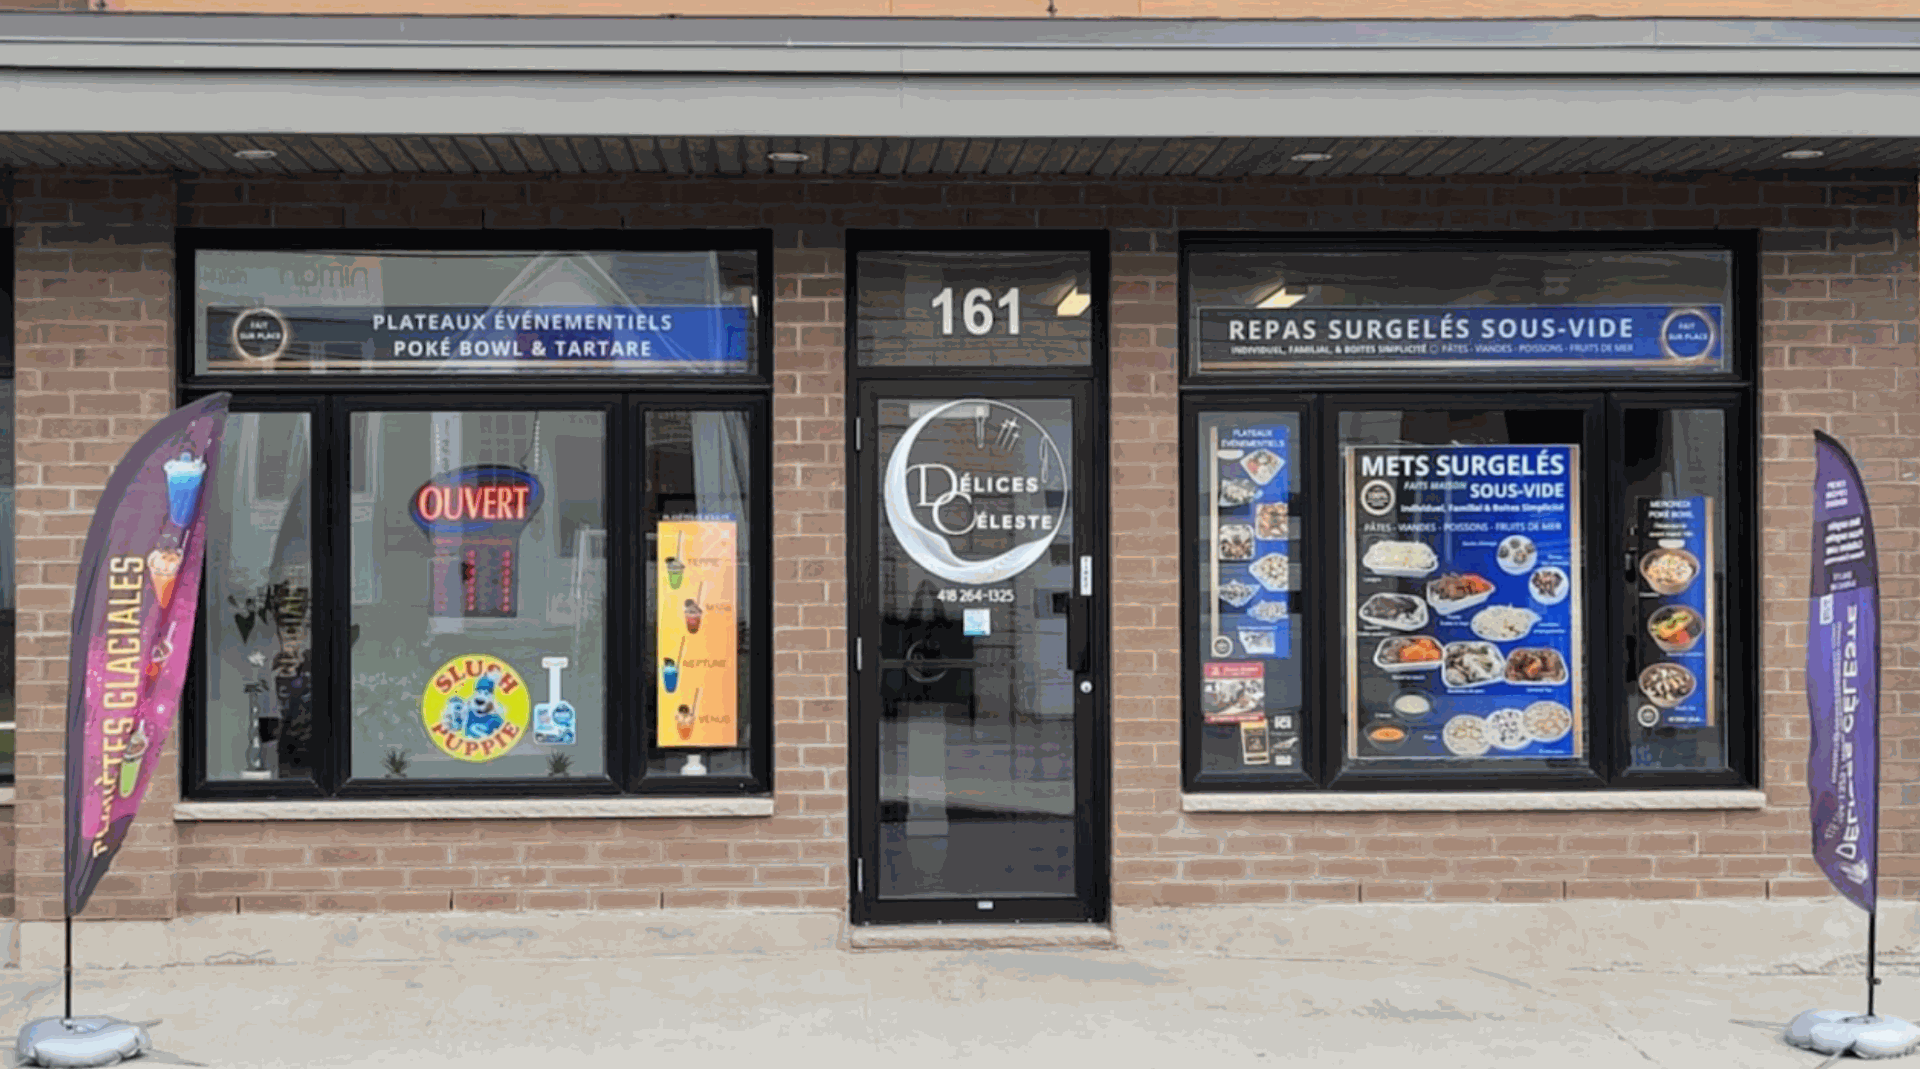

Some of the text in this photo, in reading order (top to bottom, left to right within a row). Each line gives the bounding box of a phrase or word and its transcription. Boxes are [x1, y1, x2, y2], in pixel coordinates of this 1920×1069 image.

[373, 310, 672, 331] PLATEAUX ÉVÉNEMENTIELS
[932, 287, 1020, 335] 161
[1229, 313, 1633, 340] REPAS SURGELÉS SOUS-VIDE
[394, 337, 651, 357] POKÉ BOWL & TARTARE
[1568, 343, 1600, 353] FRUITS
[1361, 449, 1565, 476] METS SURGELÉS
[906, 463, 1039, 507] DÉLICES
[1470, 482, 1565, 499] SOUS-VIDE
[419, 485, 530, 520] OUVERT
[932, 491, 1053, 535] CÉLESTE
[937, 589, 1015, 603] 418 264-1325
[103, 555, 145, 709] GLACIALES
